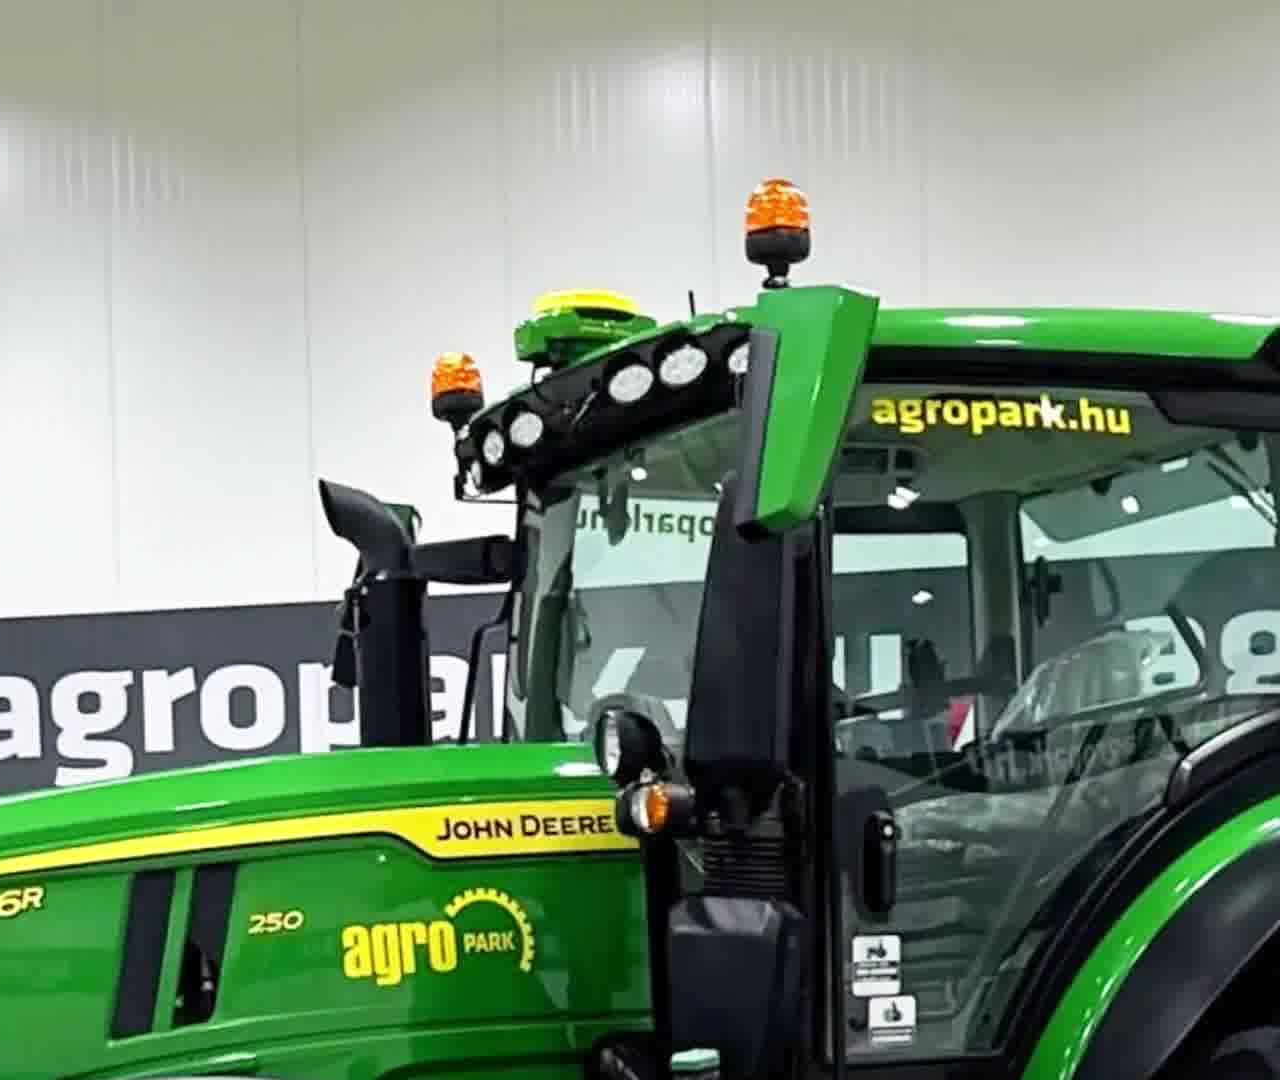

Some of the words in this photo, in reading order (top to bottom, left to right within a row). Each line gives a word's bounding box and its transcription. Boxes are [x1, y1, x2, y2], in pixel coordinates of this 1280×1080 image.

[871, 393, 1131, 435] agropark.hu
[437, 817, 513, 841] JOHN
[521, 815, 613, 837] DEERE
[248, 910, 304, 935] 250
[342, 920, 458, 986] agro
[463, 931, 516, 954] PARK
